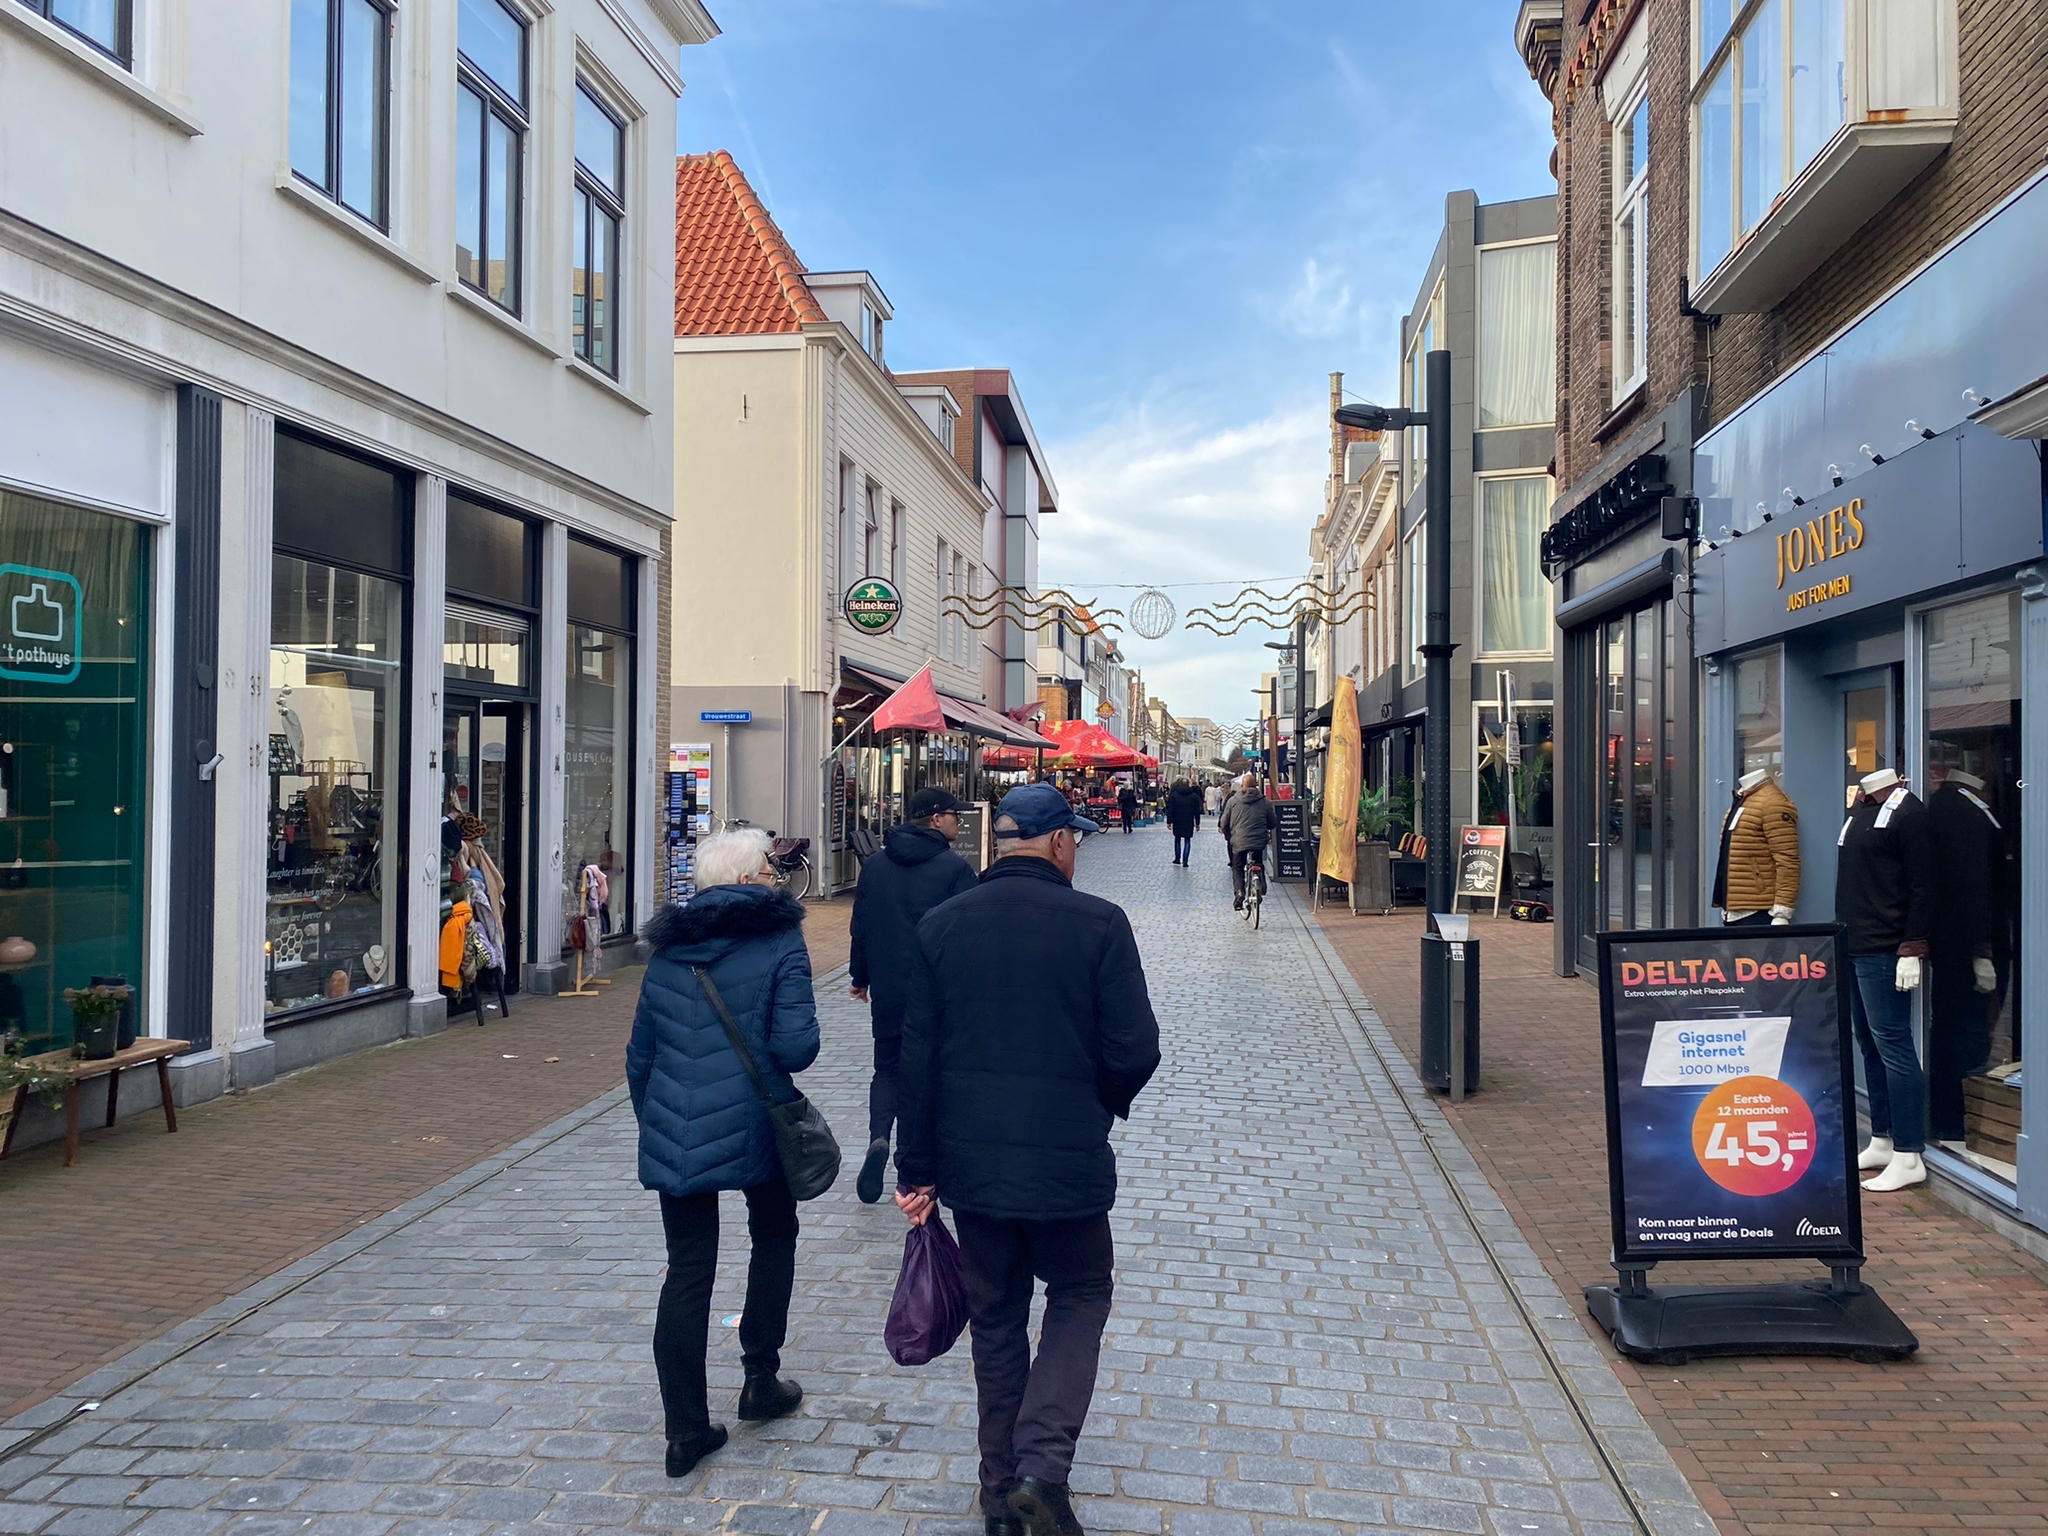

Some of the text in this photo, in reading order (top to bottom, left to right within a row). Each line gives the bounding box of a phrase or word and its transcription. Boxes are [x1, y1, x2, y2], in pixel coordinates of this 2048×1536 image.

[1776, 497, 1864, 590] JONES
[1786, 574, 1850, 612] JUST FOR MEN
[849, 600, 897, 610] Heineken
[16, 646, 71, 668] pothuys
[565, 752, 588, 762] OUSE
[1469, 849, 1493, 857] COFFEE
[295, 866, 301, 875] is
[301, 865, 325, 876] timeless
[300, 910, 323, 923] forever
[1621, 953, 1827, 986] DELTA Deals
[1624, 990, 1645, 998] Extra
[1646, 988, 1678, 997] voordeel
[1678, 989, 1689, 997] op
[1704, 986, 1745, 997] Flexpakket
[1678, 1030, 1747, 1047] Gigasnel
[1682, 1045, 1745, 1058] internet
[1679, 1064, 1750, 1076] 1000 Mbps
[1733, 1094, 1771, 1104] Eerste
[1717, 1105, 1789, 1116] 12 maanden
[1788, 1131, 1807, 1139] p/mnd
[1638, 1216, 1738, 1228] Kom naar binnen
[1639, 1227, 1774, 1242] en vraag naar de Deals
[1812, 1226, 1842, 1236] DELTA
